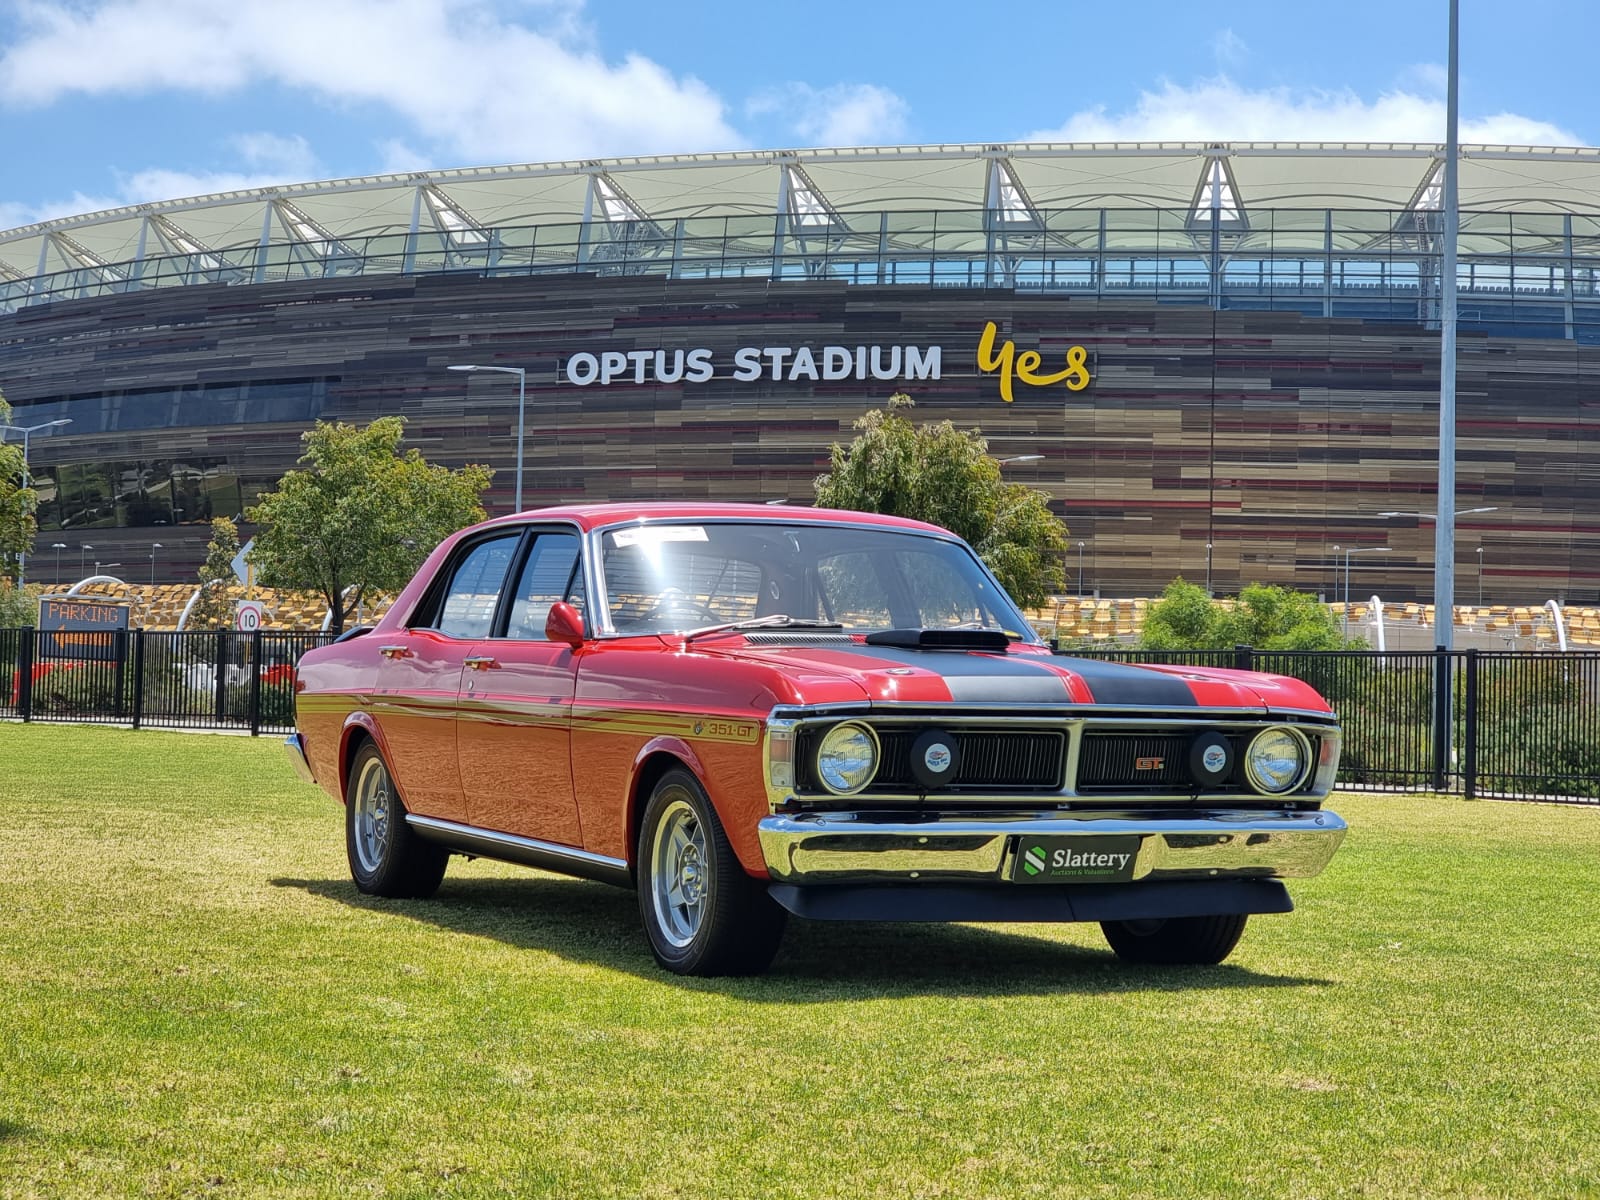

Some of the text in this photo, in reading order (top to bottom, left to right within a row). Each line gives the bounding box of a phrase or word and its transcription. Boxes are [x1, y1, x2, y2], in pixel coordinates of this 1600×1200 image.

[566, 346, 942, 385] OPTUS STADIUM
[49, 602, 118, 623] PARKING
[244, 614, 256, 628] 10
[1052, 849, 1131, 870] Slattery
